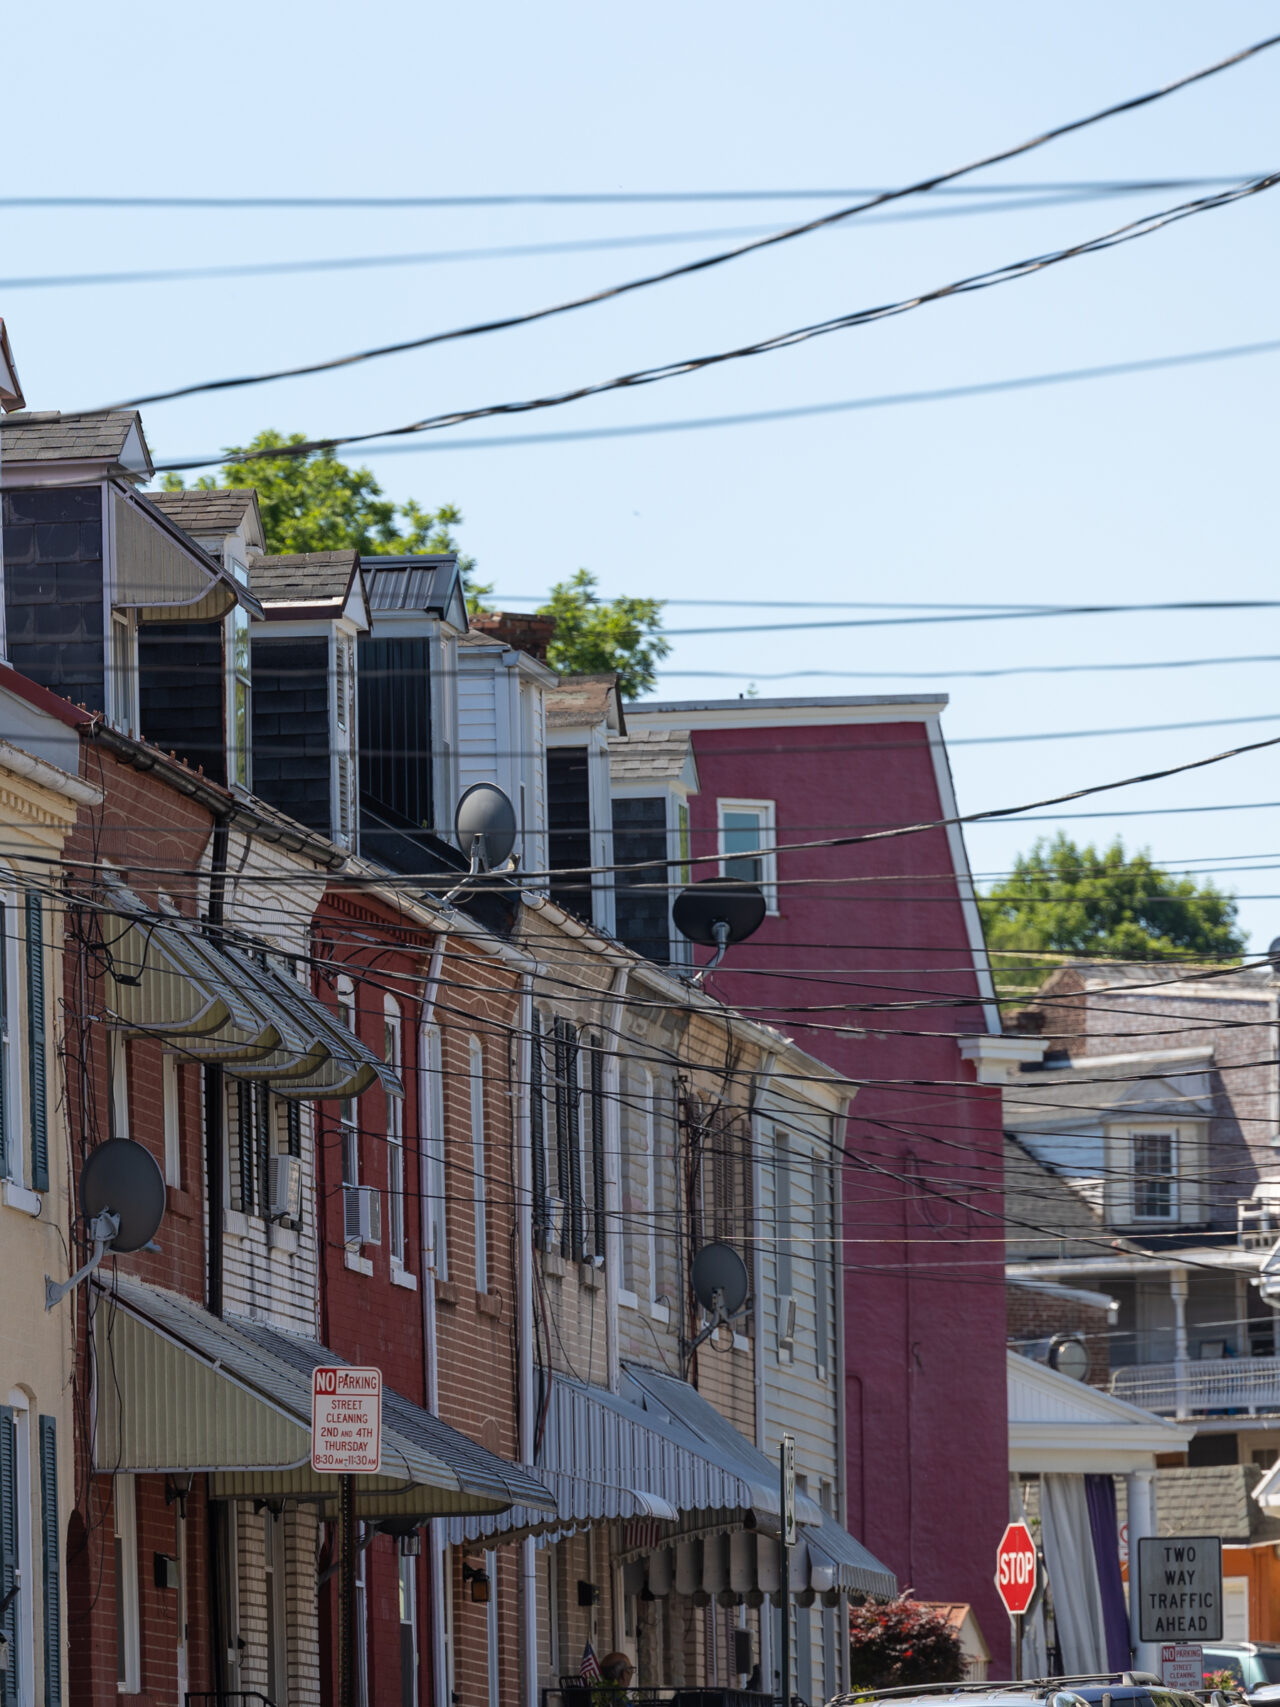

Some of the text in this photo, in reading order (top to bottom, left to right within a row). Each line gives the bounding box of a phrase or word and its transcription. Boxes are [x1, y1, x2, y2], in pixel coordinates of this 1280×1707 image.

[316, 1372, 377, 1392] NO PARKING
[331, 1400, 363, 1410] STREET
[326, 1413, 368, 1424] CLEANING
[320, 1427, 373, 1438] 2ND AND 4TH
[324, 1441, 369, 1452] THURSDAY
[1164, 1546, 1196, 1562] TWO
[1000, 1551, 1034, 1586] STOP
[1164, 1570, 1195, 1585] WAY
[1149, 1592, 1213, 1609] TRAFFIC
[1155, 1616, 1207, 1632] AHEAD
[1163, 1648, 1201, 1660] NO PARKING
